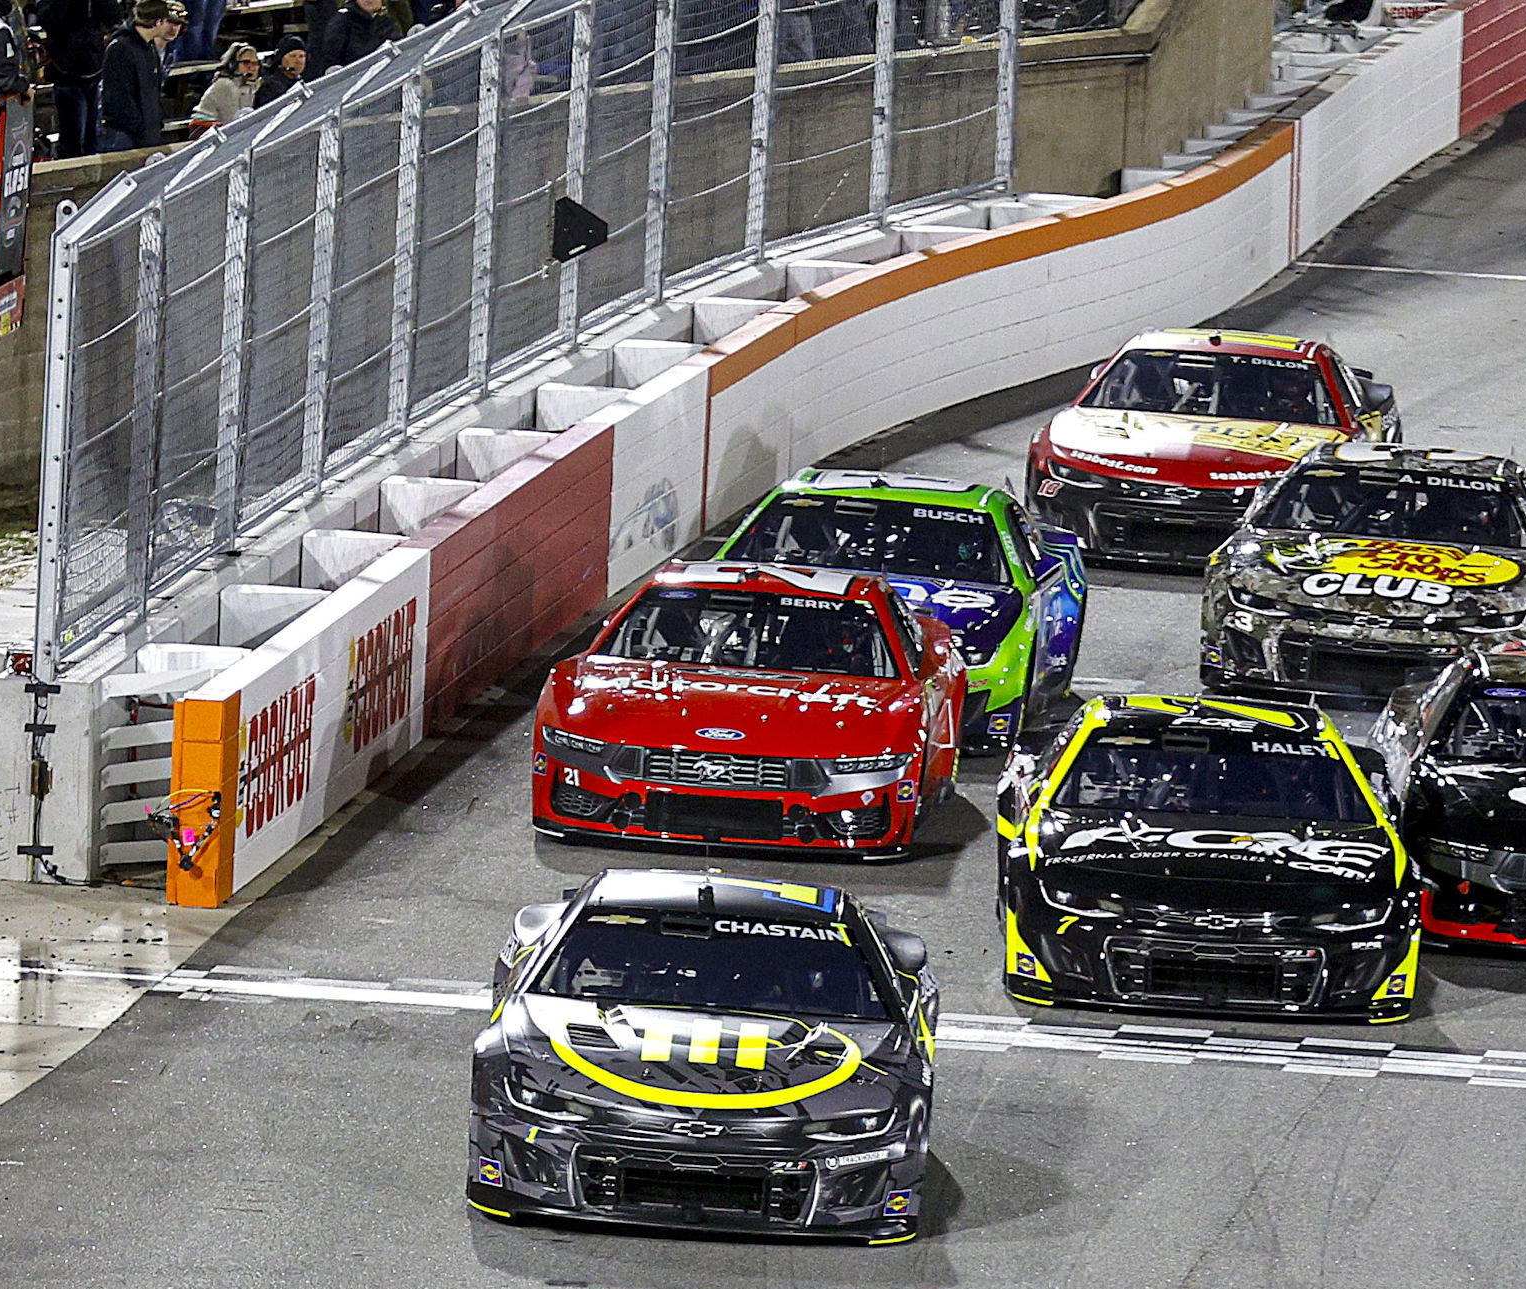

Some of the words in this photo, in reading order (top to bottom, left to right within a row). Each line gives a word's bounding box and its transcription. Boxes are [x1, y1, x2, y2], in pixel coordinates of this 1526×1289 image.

[1230, 356, 1247, 366] T.
[1251, 357, 1309, 371] DILLON
[1069, 448, 1159, 476] seabest.com
[1209, 467, 1287, 482] seabest.c
[1398, 474, 1422, 486] A.
[1426, 475, 1503, 493] DILLON
[1036, 478, 1065, 499] 10
[913, 507, 985, 526] BUSCH
[1360, 550, 1441, 566] Pro
[1358, 557, 1487, 584] Shops
[1301, 572, 1455, 605] CLUB
[780, 596, 845, 612] BERRY
[1234, 611, 1253, 632] 3
[1251, 741, 1328, 757] HALEY
[562, 767, 581, 786] 21
[1044, 852, 1125, 868] FRATERNAL
[1129, 851, 1180, 860] ORDER
[1184, 851, 1207, 860] OF
[1209, 853, 1267, 864] EAGLES
[714, 919, 847, 942] CHASTAIN
[1056, 916, 1080, 935] 7
[524, 1125, 540, 1146] 1
